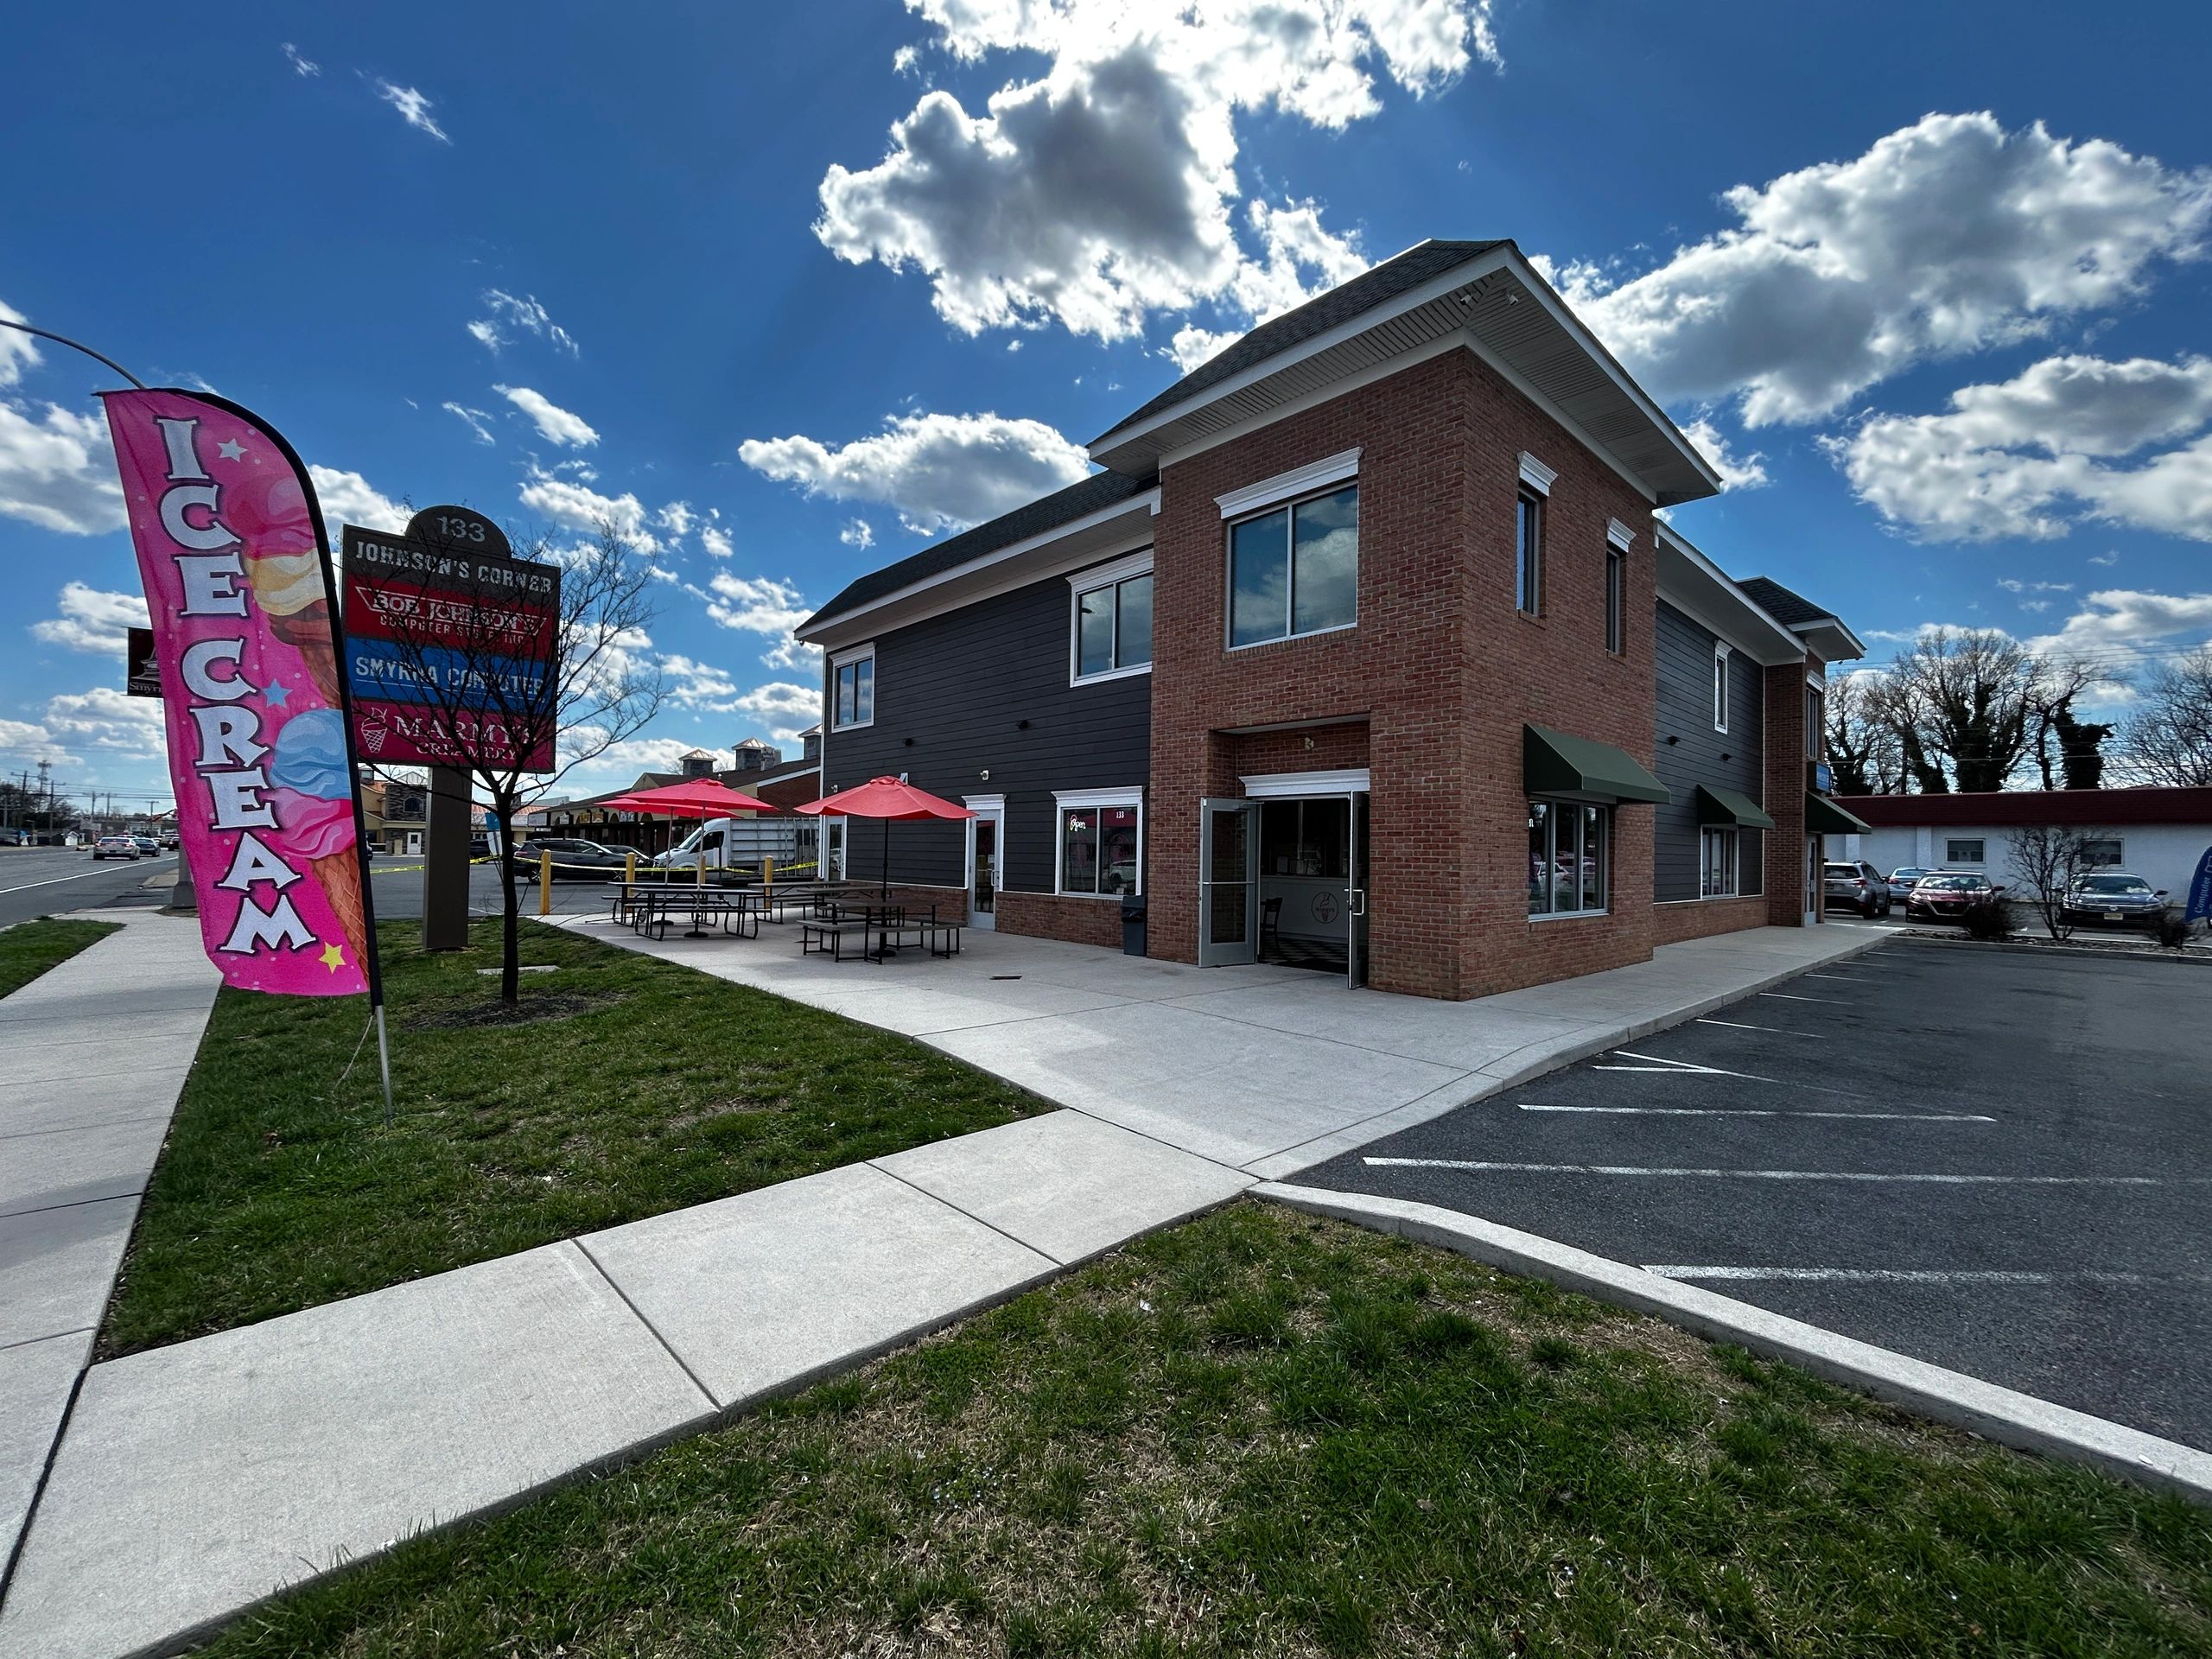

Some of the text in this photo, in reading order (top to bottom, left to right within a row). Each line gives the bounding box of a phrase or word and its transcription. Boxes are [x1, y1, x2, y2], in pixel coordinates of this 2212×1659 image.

[435, 516, 486, 543] 133
[355, 541, 552, 594] JOHNSON'S CORNER
[372, 594, 421, 615] BOB
[355, 655, 438, 683] SMYRNA
[155, 416, 319, 955] ICE CREAM
[1116, 810, 1125, 819] 133
[2195, 877, 2211, 913] Computer
